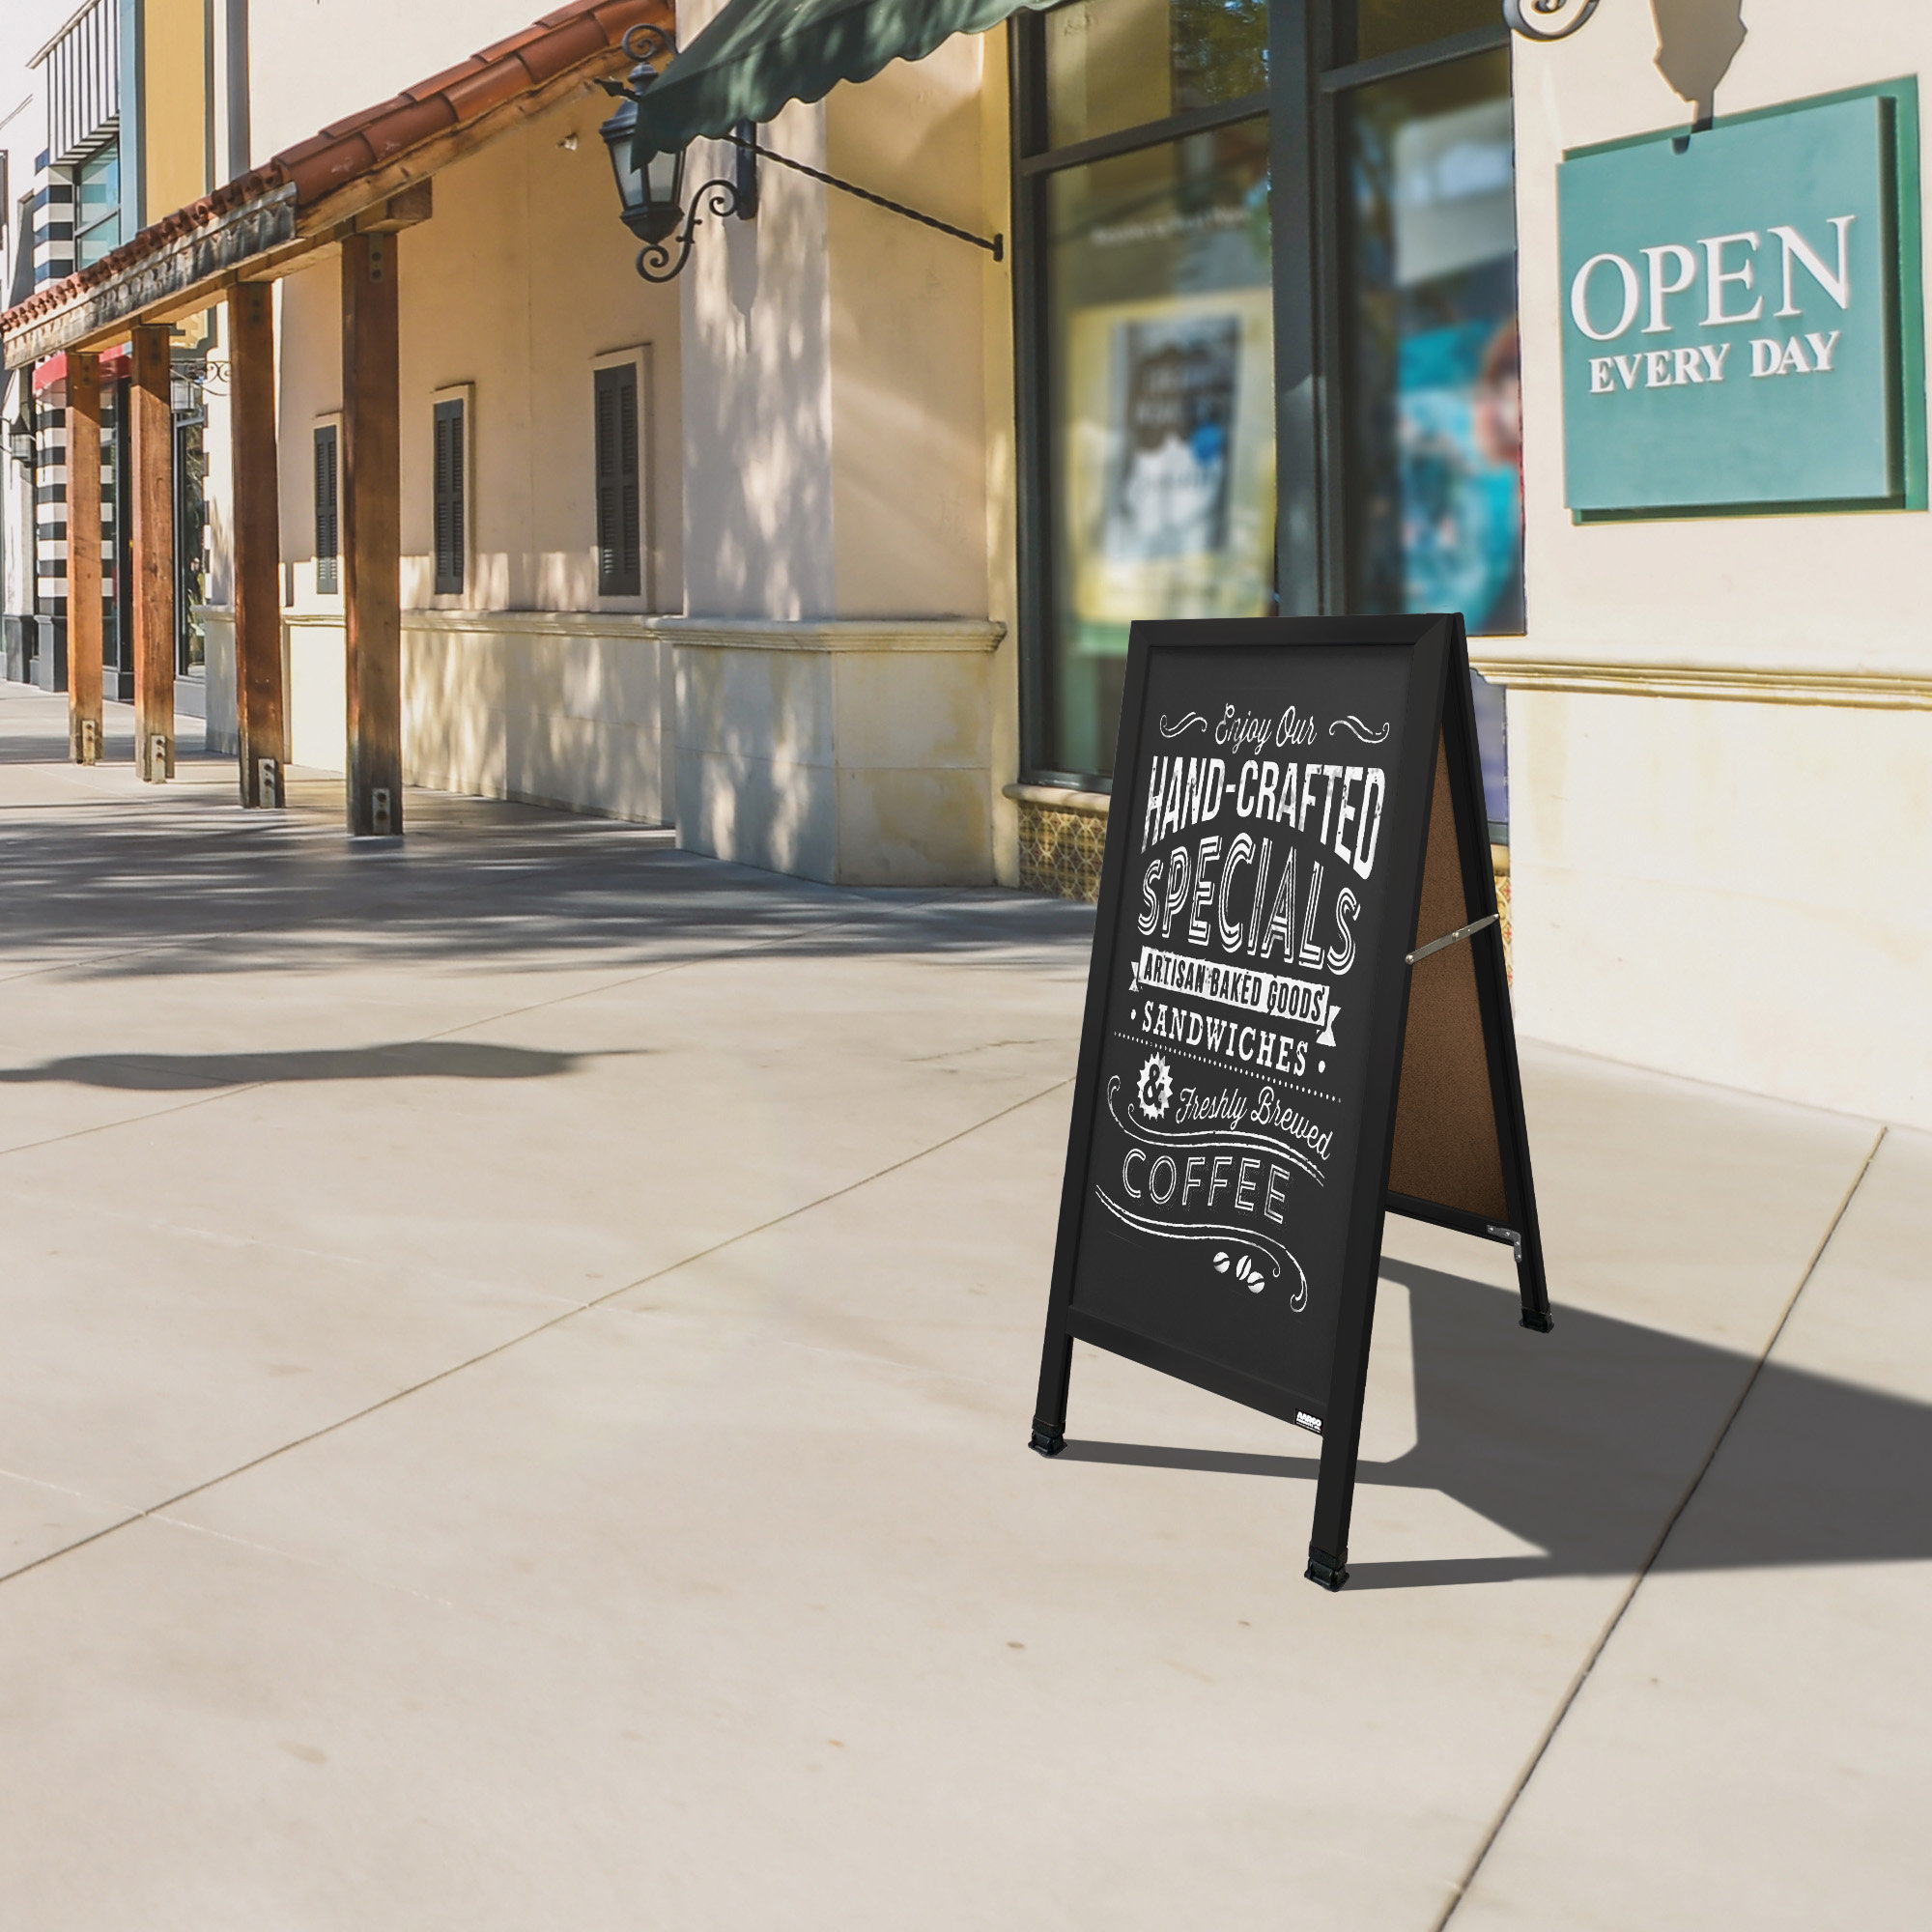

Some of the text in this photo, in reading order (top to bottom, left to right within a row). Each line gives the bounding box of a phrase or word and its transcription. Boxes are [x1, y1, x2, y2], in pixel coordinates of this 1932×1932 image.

[1571, 214, 1857, 340] OPEN
[1589, 330, 1840, 393] EVERY DAY
[1215, 703, 1317, 754] Enjoy Our
[1141, 755, 1386, 880] HAND-CRAFTED
[1137, 832, 1361, 976] SPECIALS
[1144, 952, 1324, 1022] ARTISAN BAKED GOODS
[1142, 1001, 1309, 1077] SANDWICHES
[1176, 1088, 1247, 1130] Freshly
[1250, 1086, 1333, 1160] Brewed
[1122, 1148, 1291, 1224] COFFEE
